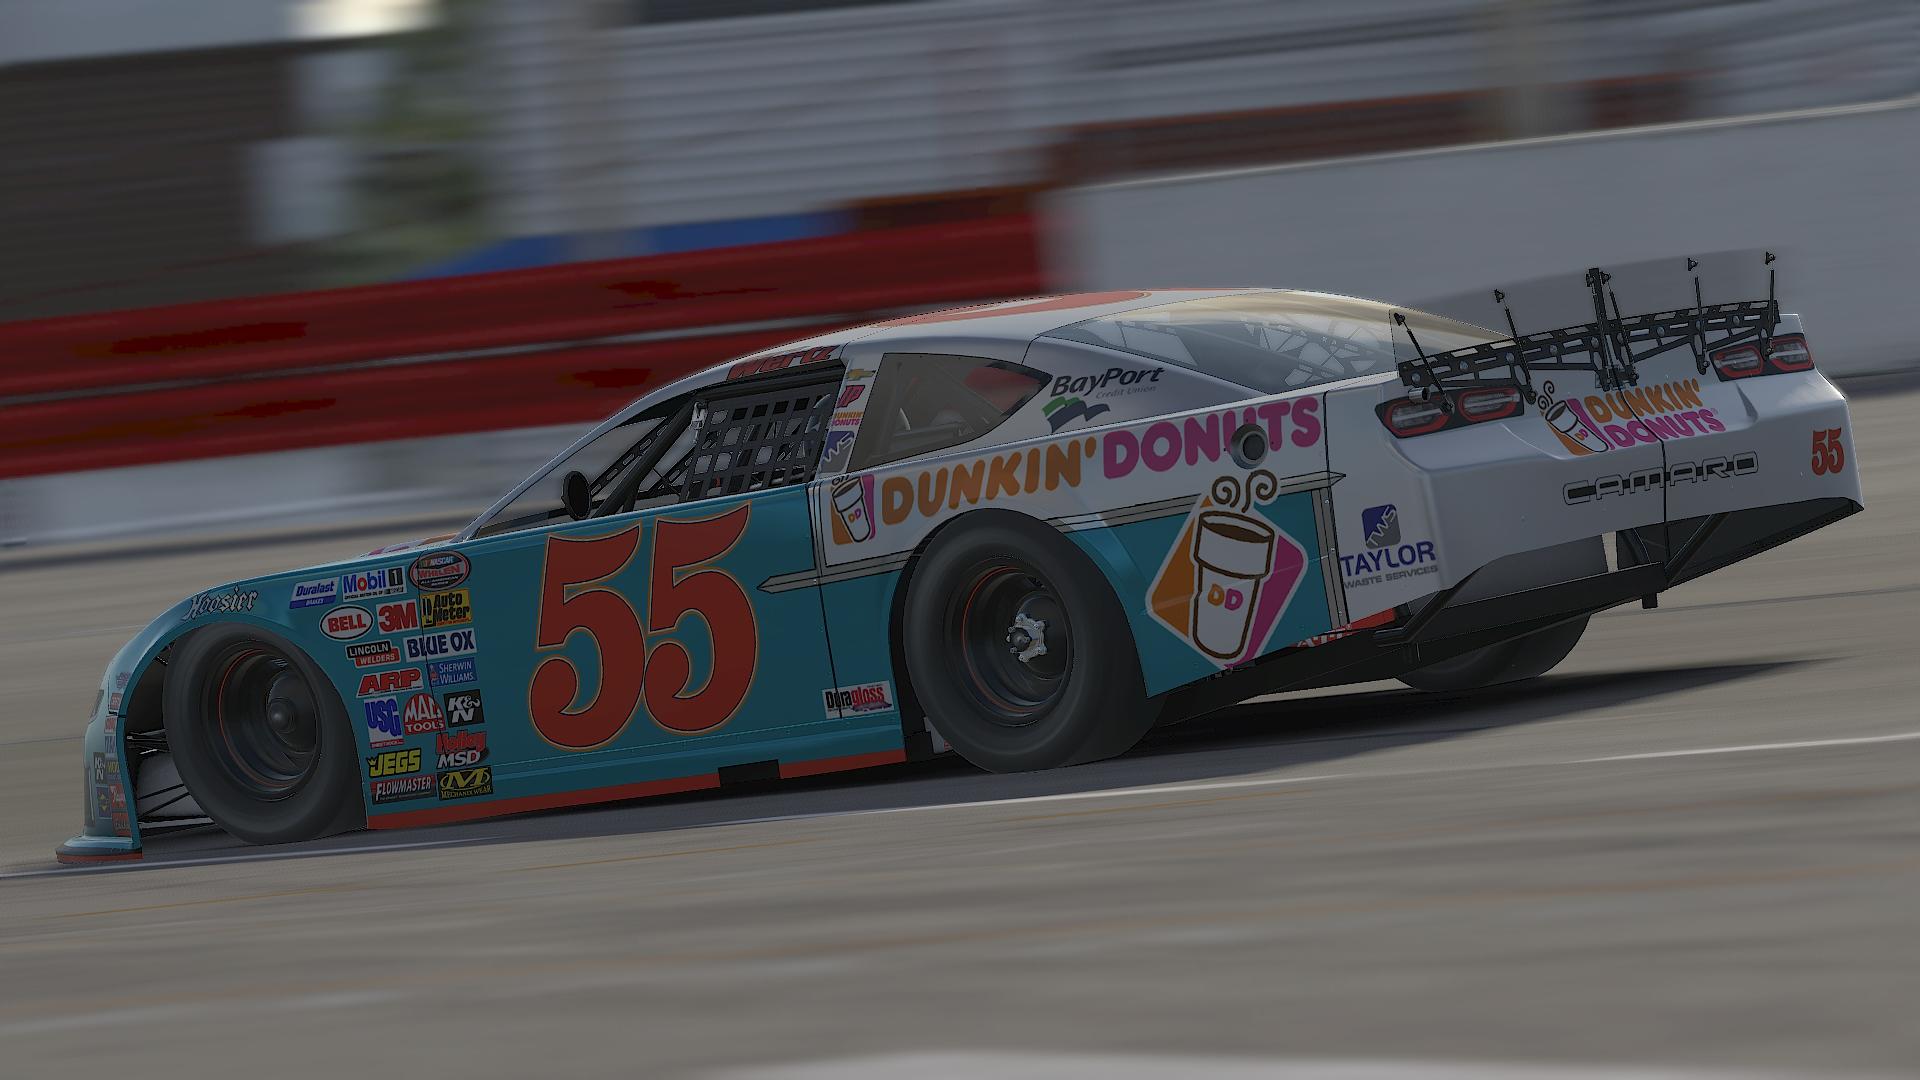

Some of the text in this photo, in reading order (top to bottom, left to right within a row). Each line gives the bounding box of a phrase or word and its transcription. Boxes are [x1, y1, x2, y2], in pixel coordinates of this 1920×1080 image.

[1050, 367, 1164, 397] BayPort
[1096, 385, 1156, 399] Credit Union
[1584, 378, 1702, 423] DUNKIN'
[1604, 408, 1726, 448] DONUTS
[1811, 426, 1845, 476] 55
[881, 434, 1097, 526] DUNKIN'
[1562, 450, 1759, 506] CAMARO
[1340, 541, 1436, 577] TAYLOR
[296, 581, 335, 597] Duralast
[343, 570, 386, 594] Mobil
[1344, 565, 1439, 590] WASTE SERVICES
[181, 584, 259, 621] Hoosier
[433, 592, 463, 609] Auto
[328, 614, 366, 633] BELL
[379, 602, 419, 632] 3M
[432, 606, 470, 622] Meter
[529, 500, 758, 751] 55
[349, 643, 389, 656] LINCOLN
[407, 630, 475, 658] BLUE OX
[360, 654, 395, 665] WELDERS
[439, 661, 472, 673] SHERWIN
[358, 669, 421, 696] ARP
[440, 675, 474, 685] WILLIAMS
[365, 698, 402, 737] USG
[405, 721, 443, 733] TOOLS
[369, 749, 421, 777] JEGS
[438, 750, 480, 768] MSD
[376, 776, 431, 801] FLOWMASTER
